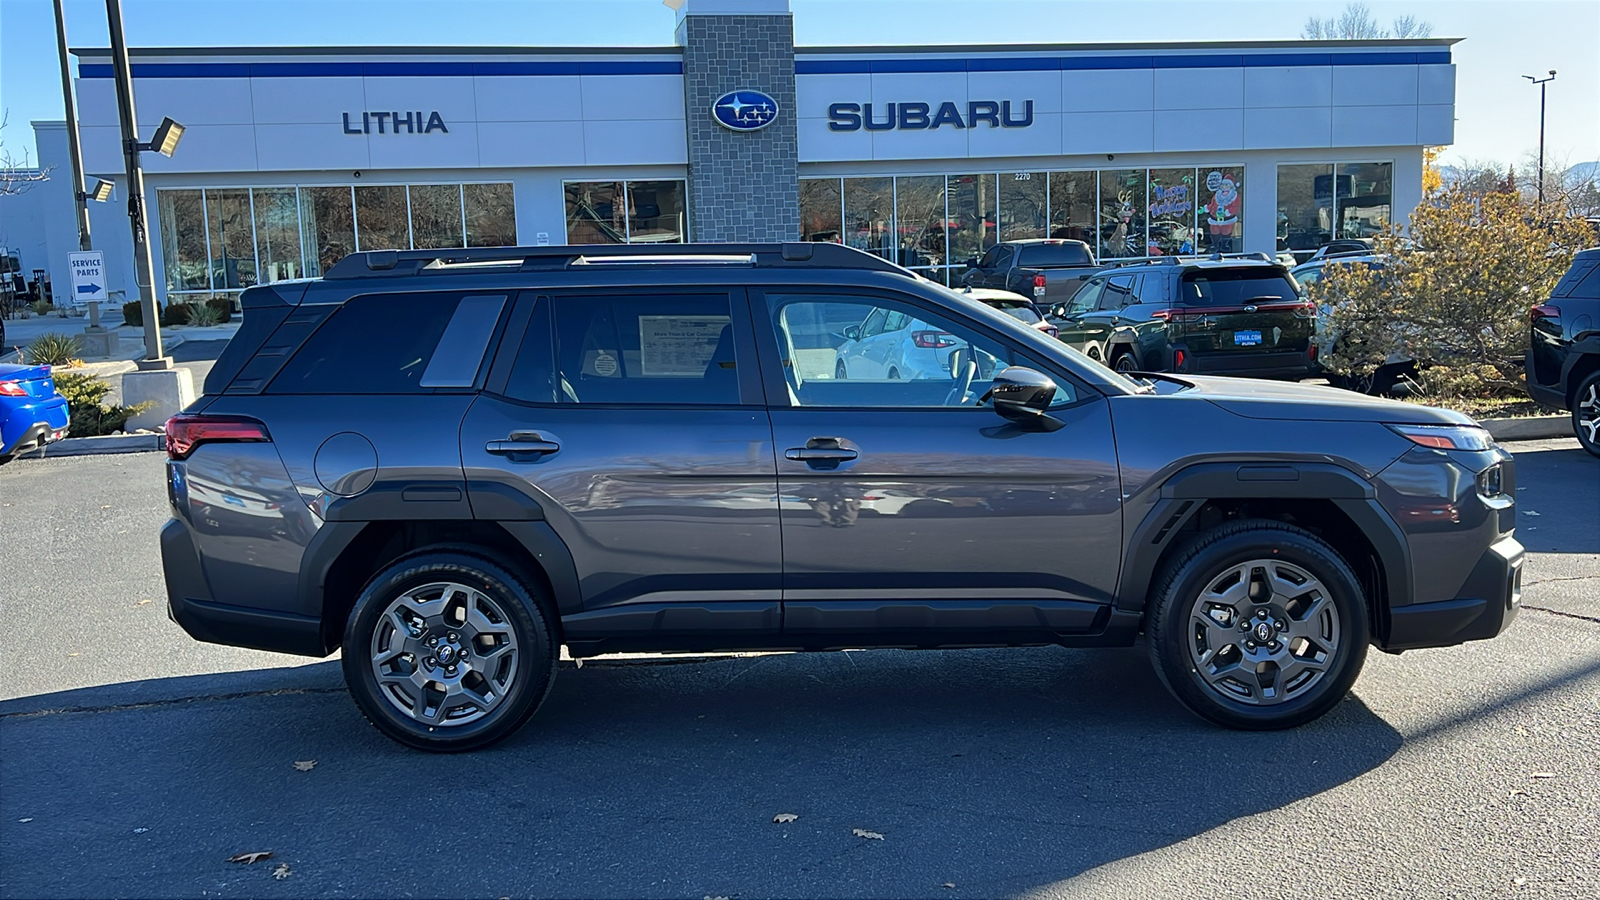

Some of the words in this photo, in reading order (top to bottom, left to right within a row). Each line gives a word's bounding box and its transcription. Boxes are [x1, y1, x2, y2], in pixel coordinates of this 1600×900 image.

[342, 111, 449, 134] LITHIA
[828, 100, 1033, 131] SUBARU
[1153, 185, 1187, 200] Happy
[72, 259, 101, 267] SERVICE
[391, 562, 507, 593] GRANDTREK
